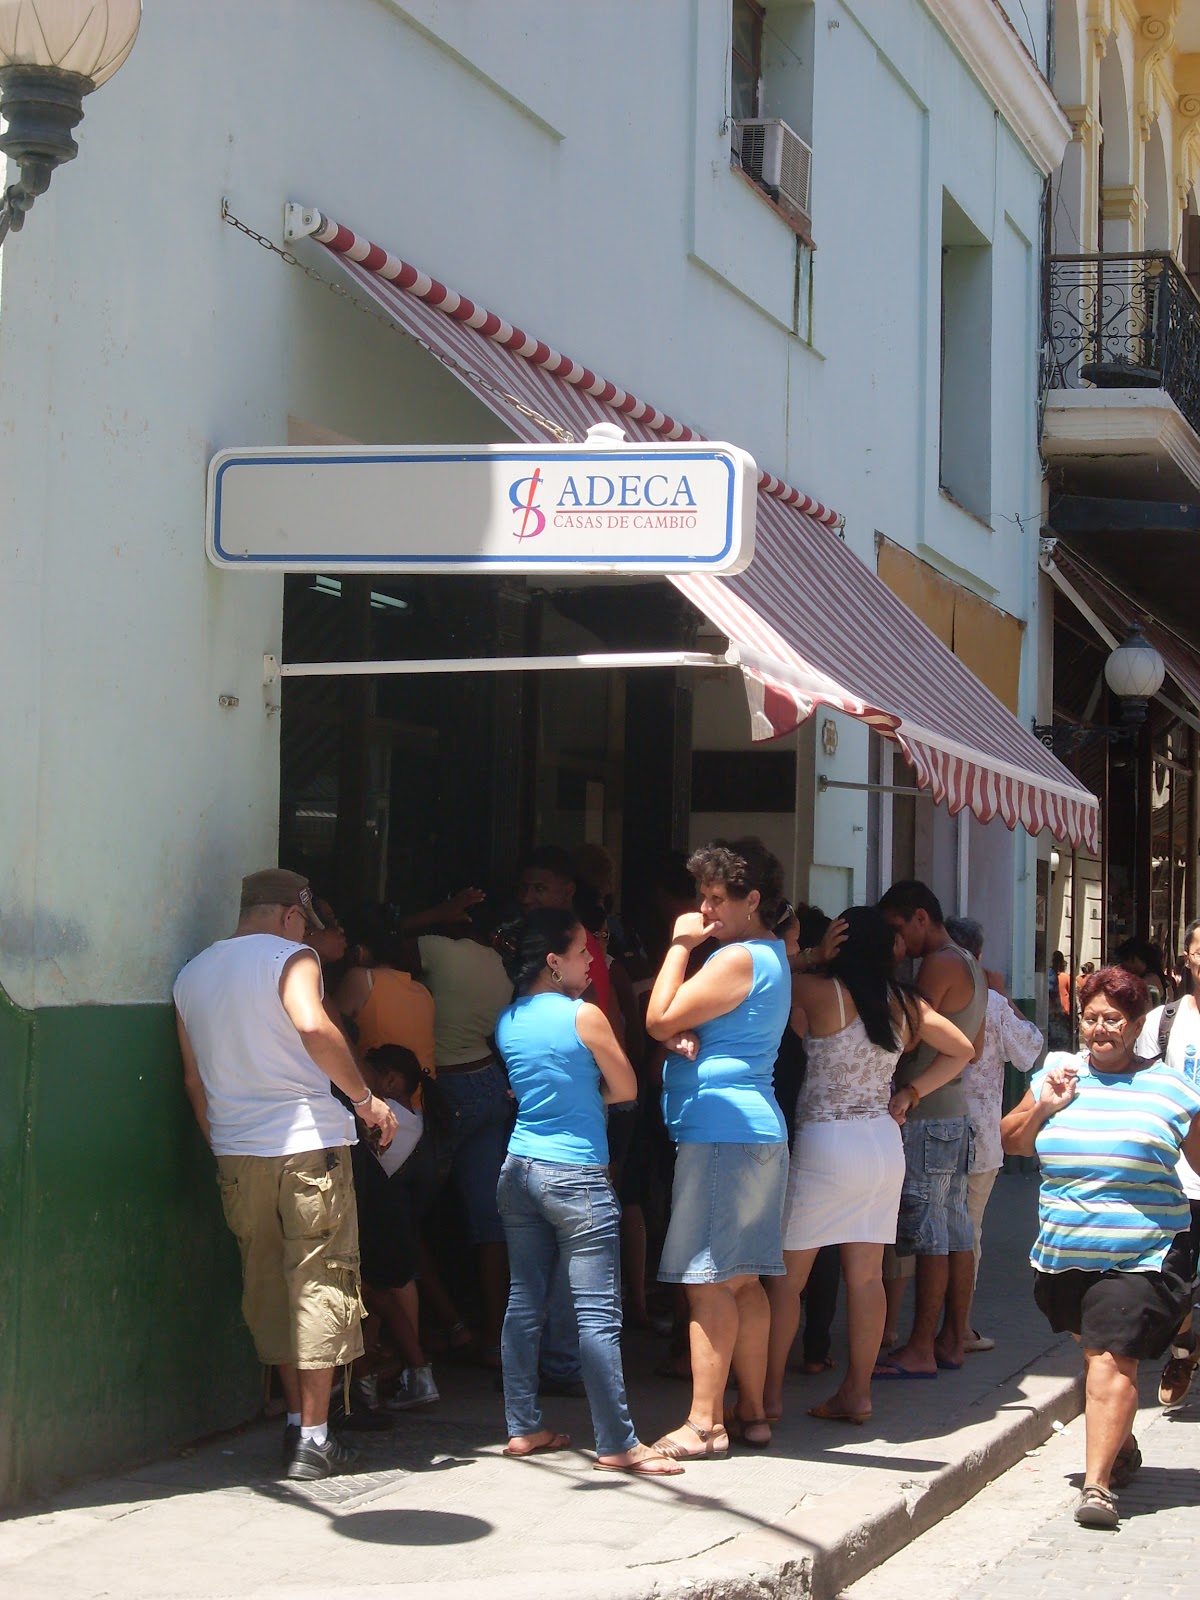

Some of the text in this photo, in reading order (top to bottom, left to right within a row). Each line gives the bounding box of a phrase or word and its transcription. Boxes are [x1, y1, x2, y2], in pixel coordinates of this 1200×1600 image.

[553, 515, 697, 529] CASAS DE CAMBIO
